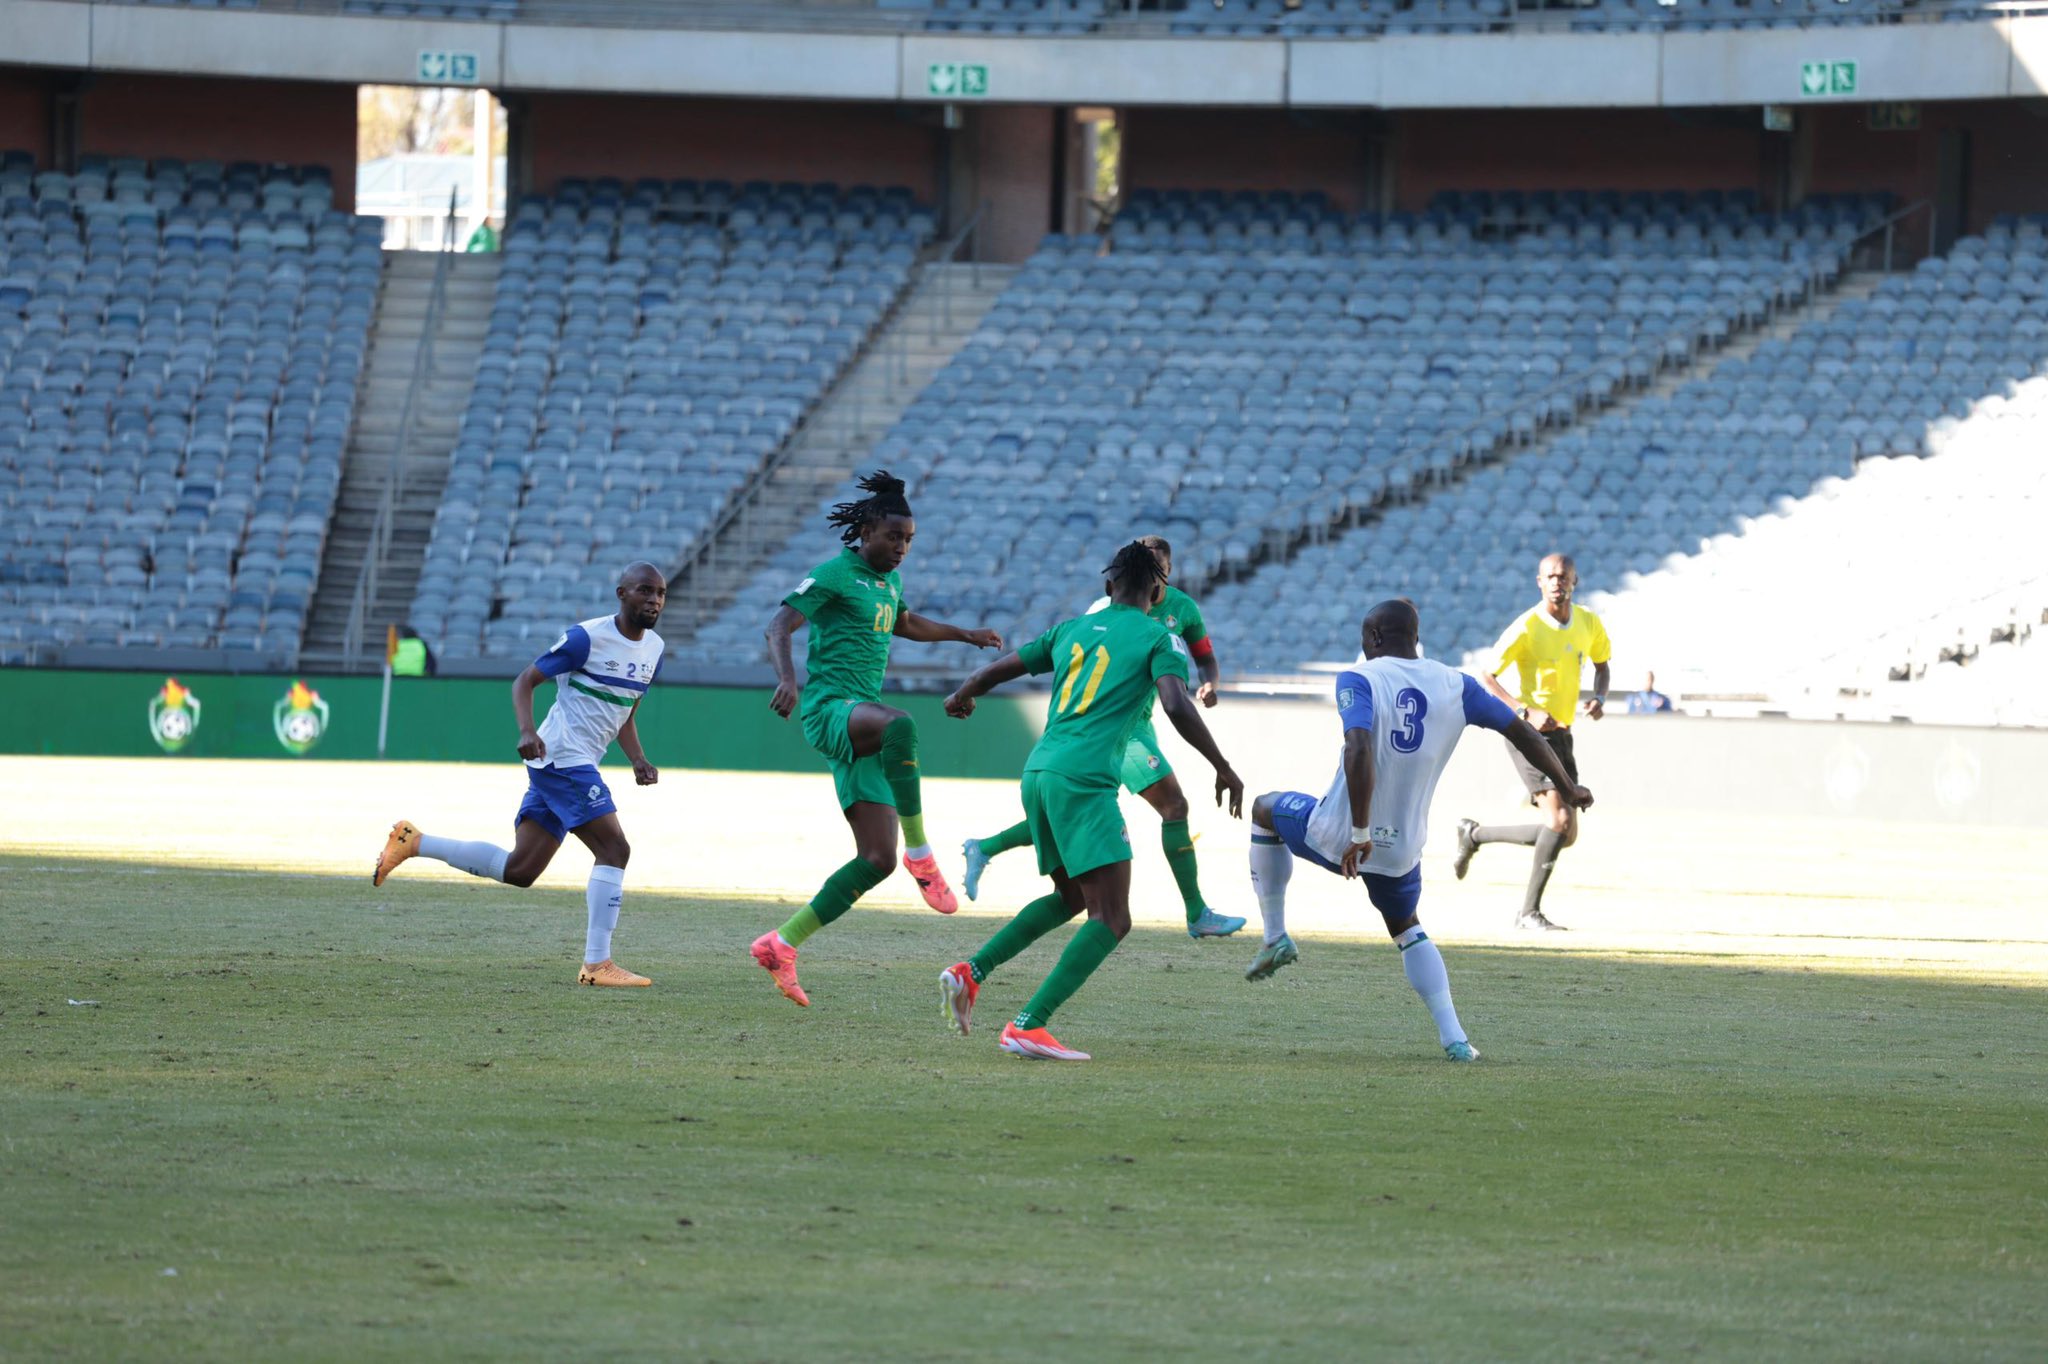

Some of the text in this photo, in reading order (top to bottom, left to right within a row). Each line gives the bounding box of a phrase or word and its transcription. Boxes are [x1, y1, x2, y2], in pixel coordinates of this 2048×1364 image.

[873, 602, 892, 632] 20
[626, 662, 637, 678] 2
[1057, 642, 1110, 715] 11
[1390, 687, 1428, 754] 3
